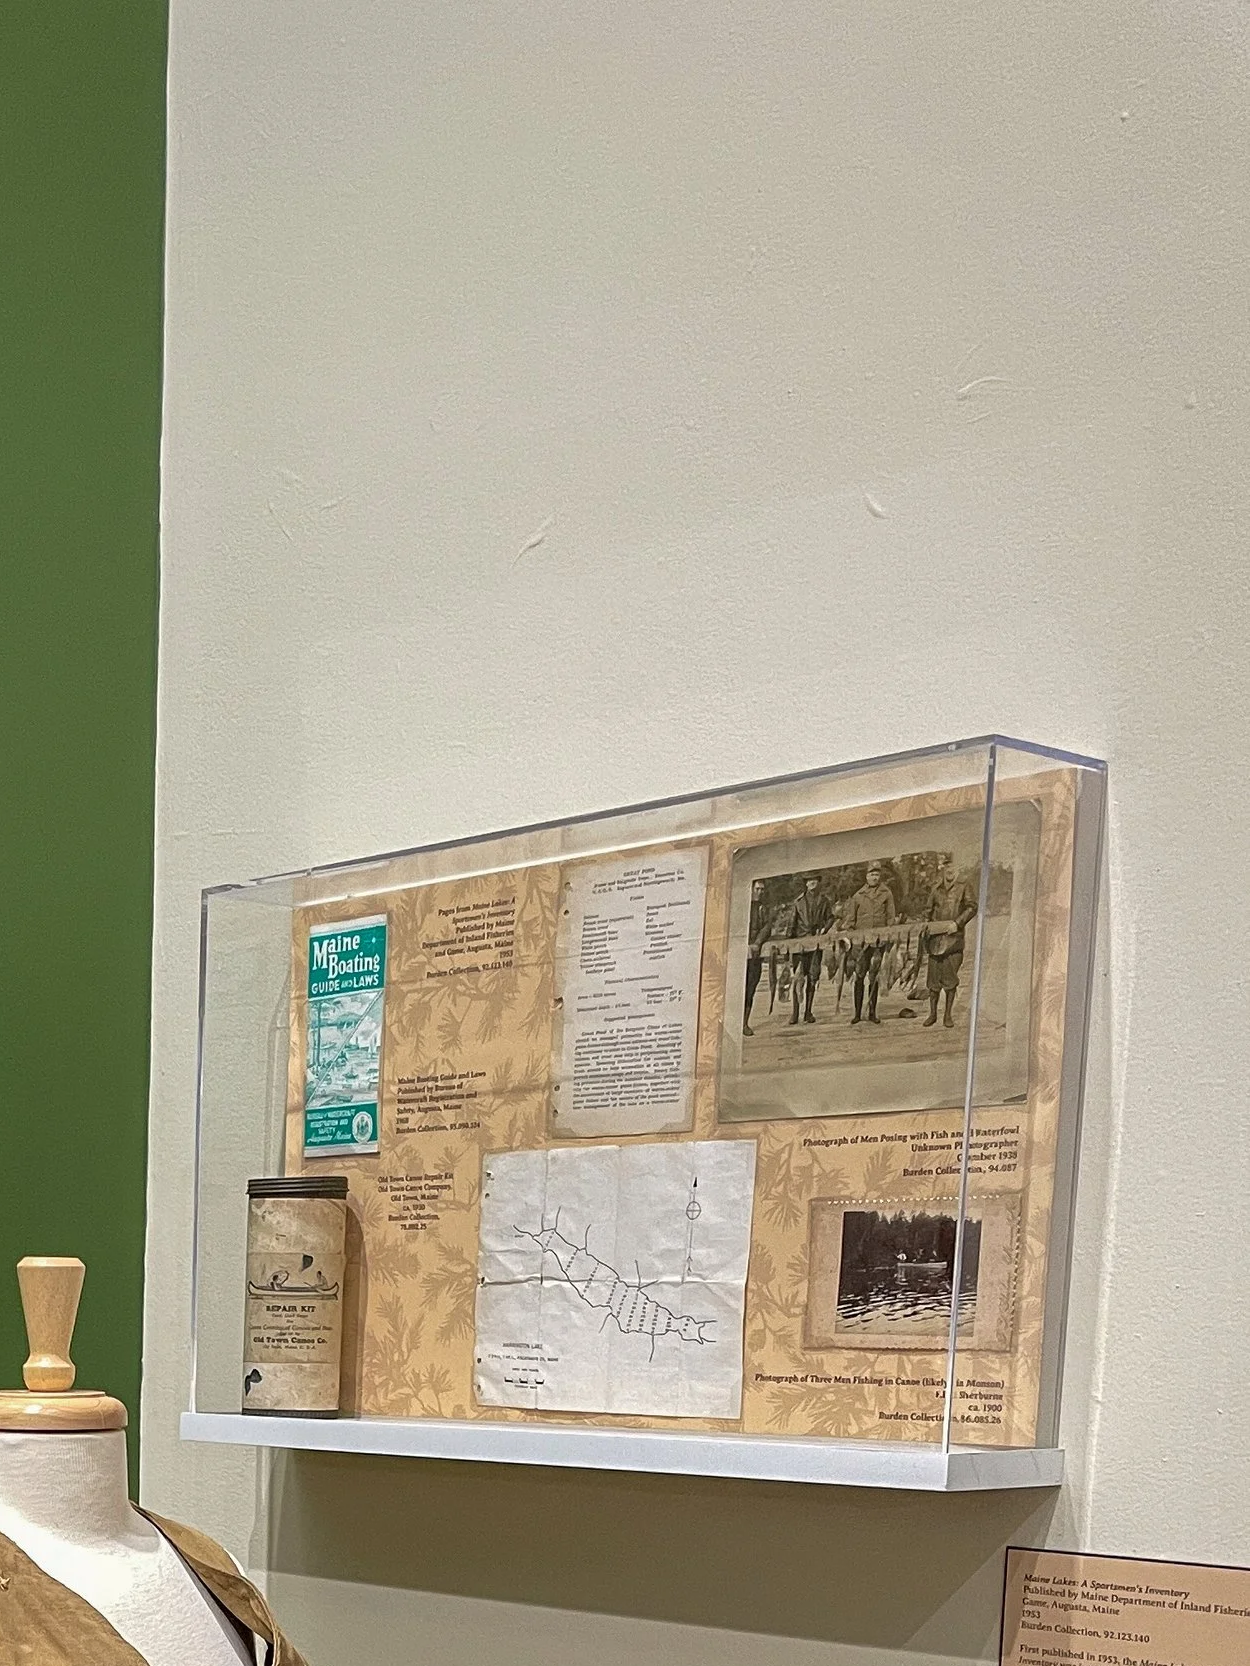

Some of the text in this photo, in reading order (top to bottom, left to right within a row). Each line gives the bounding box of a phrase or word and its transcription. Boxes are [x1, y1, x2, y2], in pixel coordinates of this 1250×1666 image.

[312, 934, 360, 970] Maine
[328, 952, 380, 979] Boating
[311, 978, 340, 994] GUIDE
[353, 974, 379, 988] LAWS
[802, 1136, 848, 1147] Photograph
[849, 1135, 859, 1143] of
[860, 1134, 878, 1143] Men
[879, 1133, 907, 1142] Posing
[909, 1131, 928, 1140] with
[930, 1130, 948, 1138] Fish
[911, 1143, 952, 1151] Unknown
[902, 1167, 933, 1176] Burden
[754, 1373, 798, 1384] Photograph
[799, 1374, 809, 1382] of
[808, 1374, 832, 1382] Three
[832, 1375, 851, 1383] Men
[852, 1375, 883, 1386] Fishing
[894, 1377, 920, 1385] Canoe
[965, 1379, 1004, 1390] Monson)
[959, 1390, 1003, 1399] Sherburne
[878, 1411, 908, 1420] Burden
[910, 1412, 959, 1423] Collectin,
[1023, 1573, 1190, 1599] Maine Lakes: A Sportsmen's Inventory
[1022, 1596, 1119, 1615] Game, Augusta, Maine
[1023, 1584, 1065, 1596] Published
[1067, 1589, 1078, 1600] by
[1080, 1590, 1109, 1601] Maine
[1110, 1593, 1165, 1607] Department
[1167, 1600, 1178, 1609] of
[1180, 1601, 1211, 1612] Inland
[1022, 1608, 1040, 1618] 1953
[1021, 1619, 1150, 1643] Burden Collection, 92.123.140
[1019, 1643, 1039, 1654] First
[1041, 1647, 1084, 1659] published
[1086, 1652, 1095, 1661] in
[1098, 1654, 1120, 1665] 1953,
[1122, 1656, 1137, 1666] the
